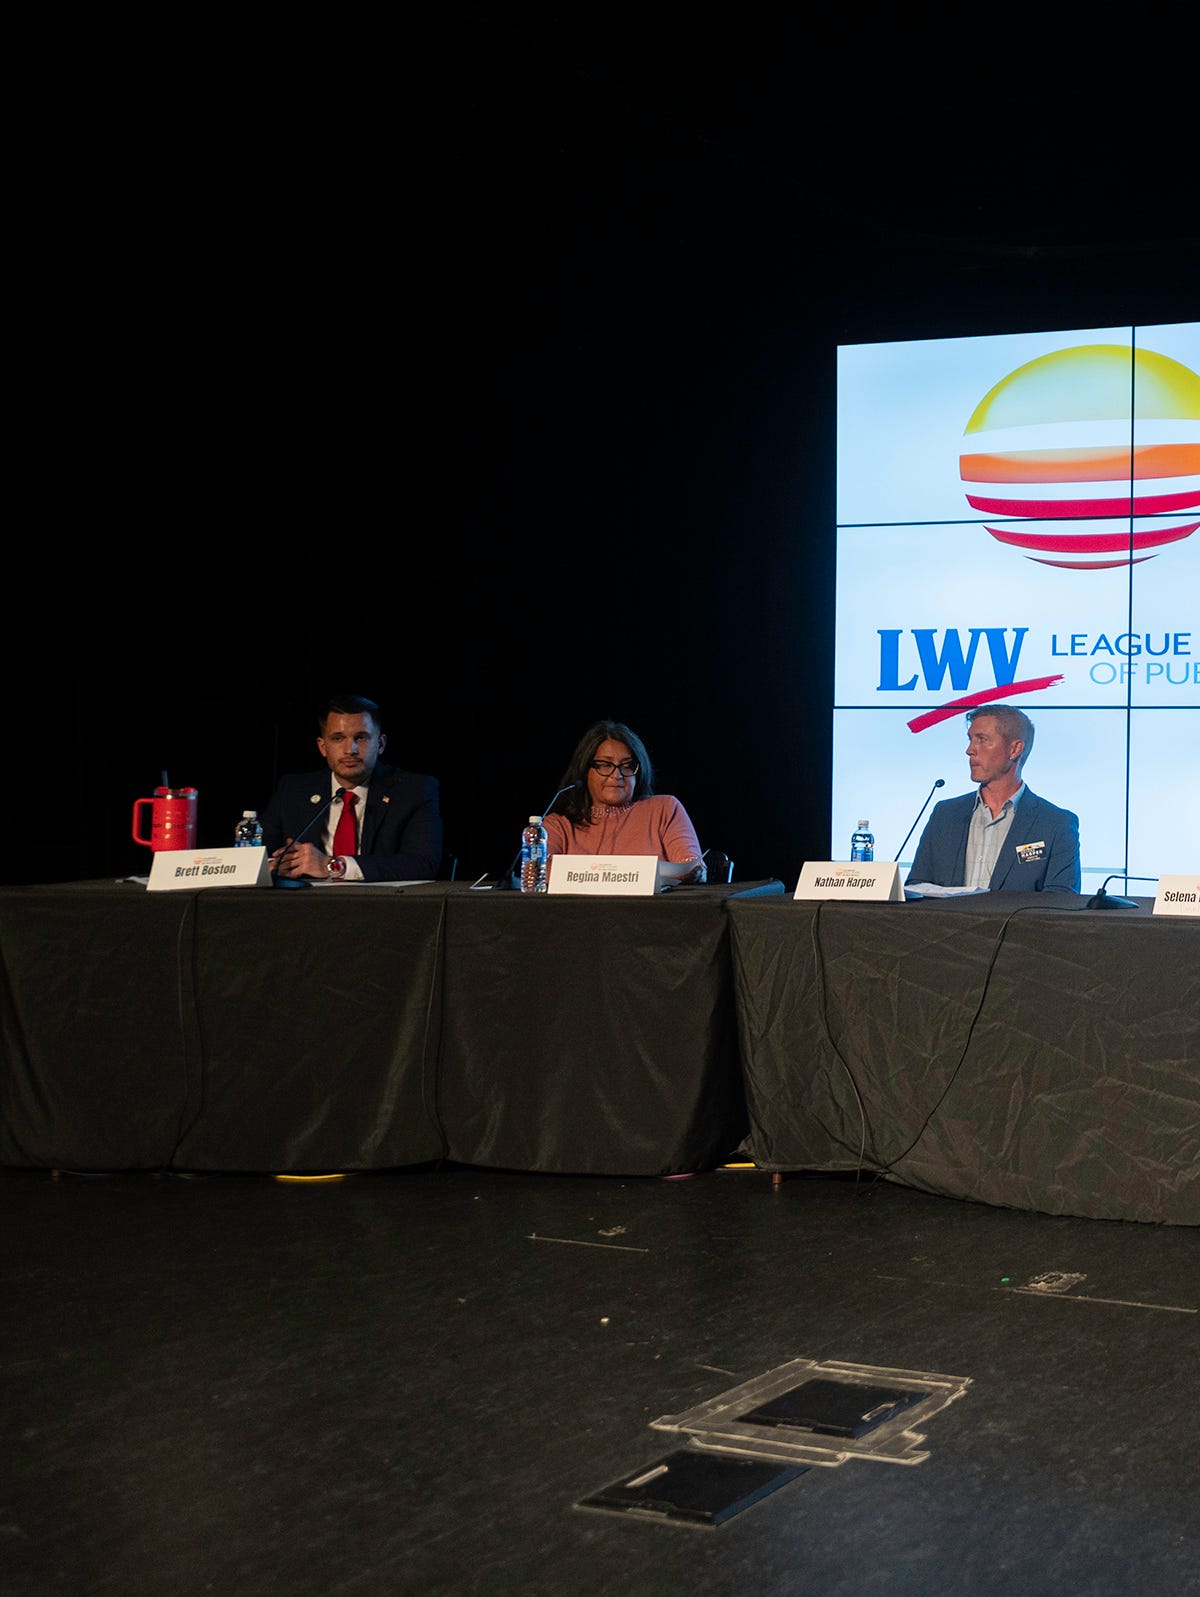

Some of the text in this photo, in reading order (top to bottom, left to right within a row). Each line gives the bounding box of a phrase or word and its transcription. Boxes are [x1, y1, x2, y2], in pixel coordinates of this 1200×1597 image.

[1051, 632, 1192, 657] LEAGUE
[876, 626, 1030, 692] LWV
[1089, 662, 1138, 685] OF
[175, 864, 236, 877] Brett Boston
[566, 870, 639, 883] Regina Maestri
[814, 877, 876, 888] Nathan Harper
[1163, 891, 1196, 902] Selena
